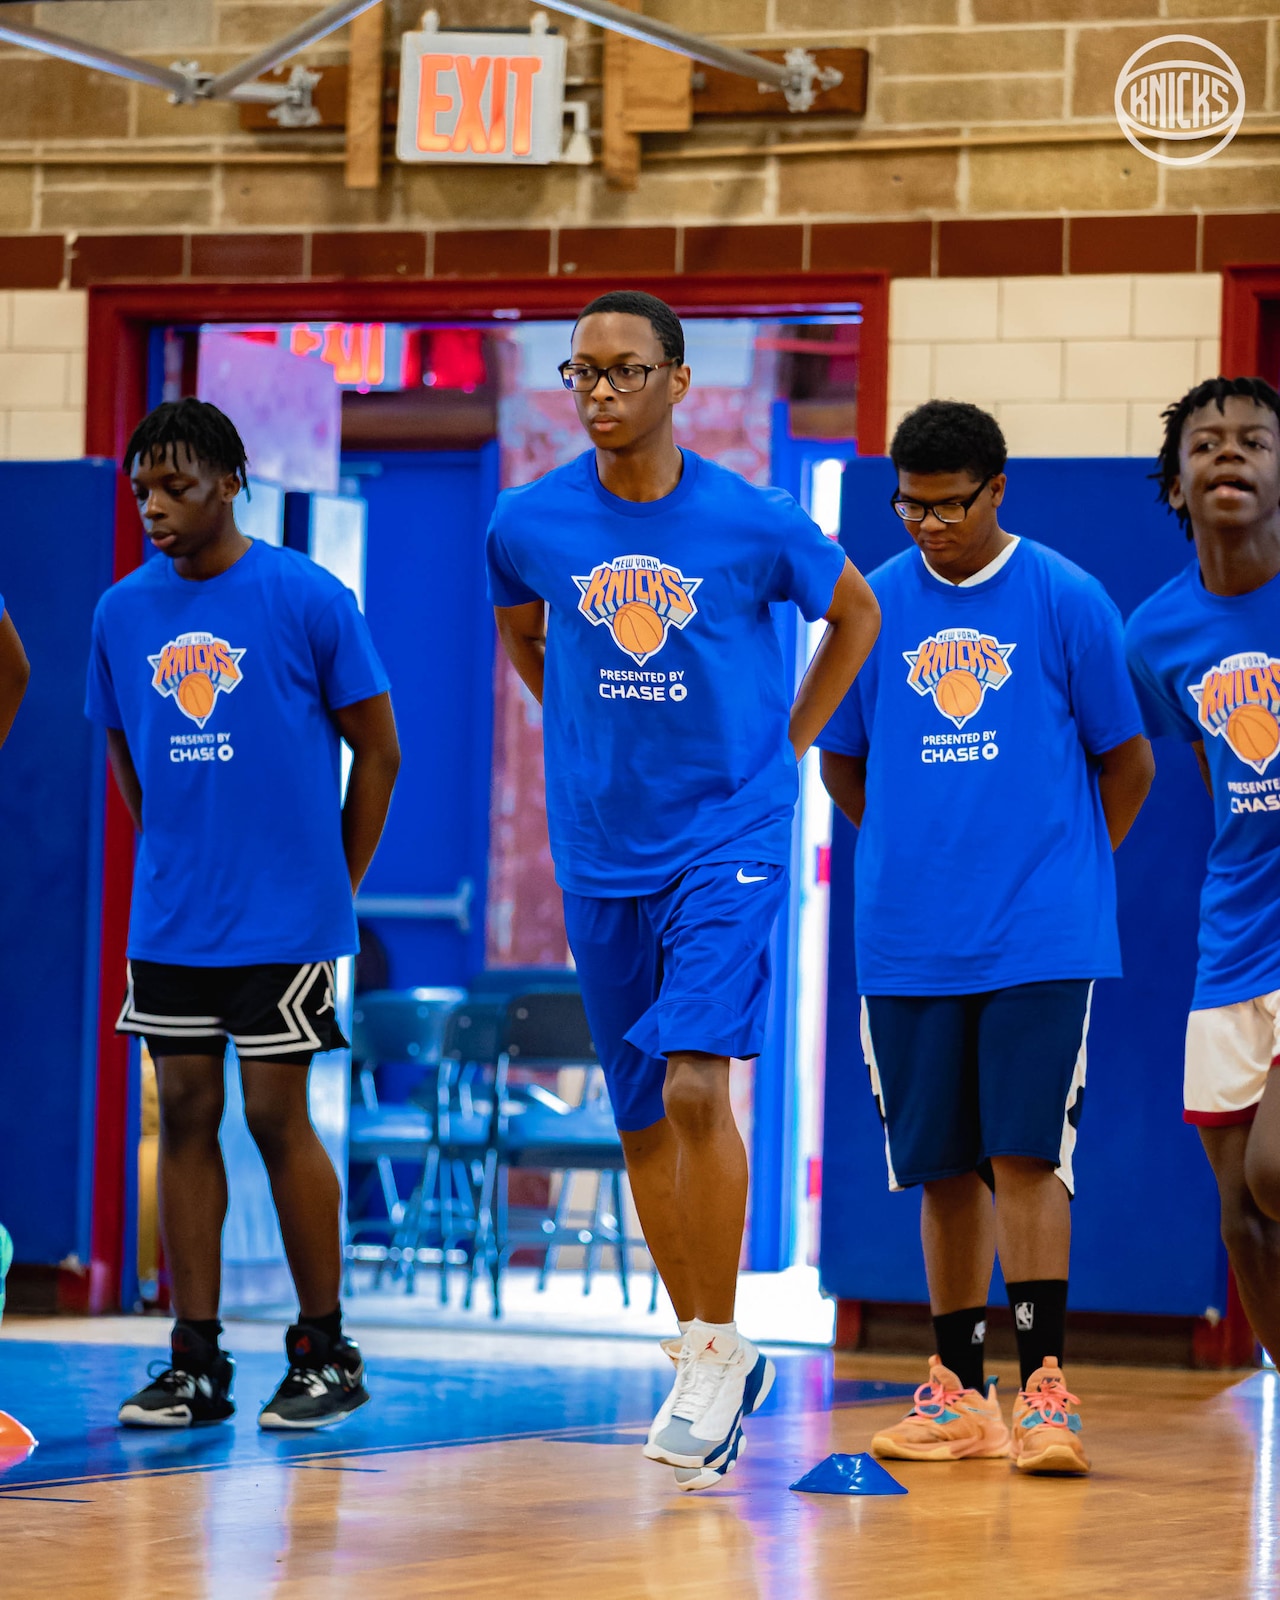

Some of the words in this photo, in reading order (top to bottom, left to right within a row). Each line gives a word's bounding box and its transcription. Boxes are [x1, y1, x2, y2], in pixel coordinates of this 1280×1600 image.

[416, 53, 542, 156] EXIT
[614, 558, 634, 570] NEW
[635, 558, 659, 570] YORK
[581, 567, 693, 615] KNICKS
[957, 631, 978, 641] YORK
[155, 641, 240, 686] KNICKS
[910, 637, 1009, 683] KNICKS
[599, 668, 666, 683] PRESENTED
[669, 670, 685, 682] BY
[599, 683, 667, 702] CHASE
[170, 733, 215, 746] PRESENTED
[217, 732, 231, 744] BY
[922, 732, 981, 746] PRESENTED
[982, 730, 997, 742] BY
[170, 747, 216, 763] CHASE
[921, 746, 980, 764] CHASE
[1227, 777, 1280, 795] PRESENTE
[1230, 794, 1280, 814] CHAS
